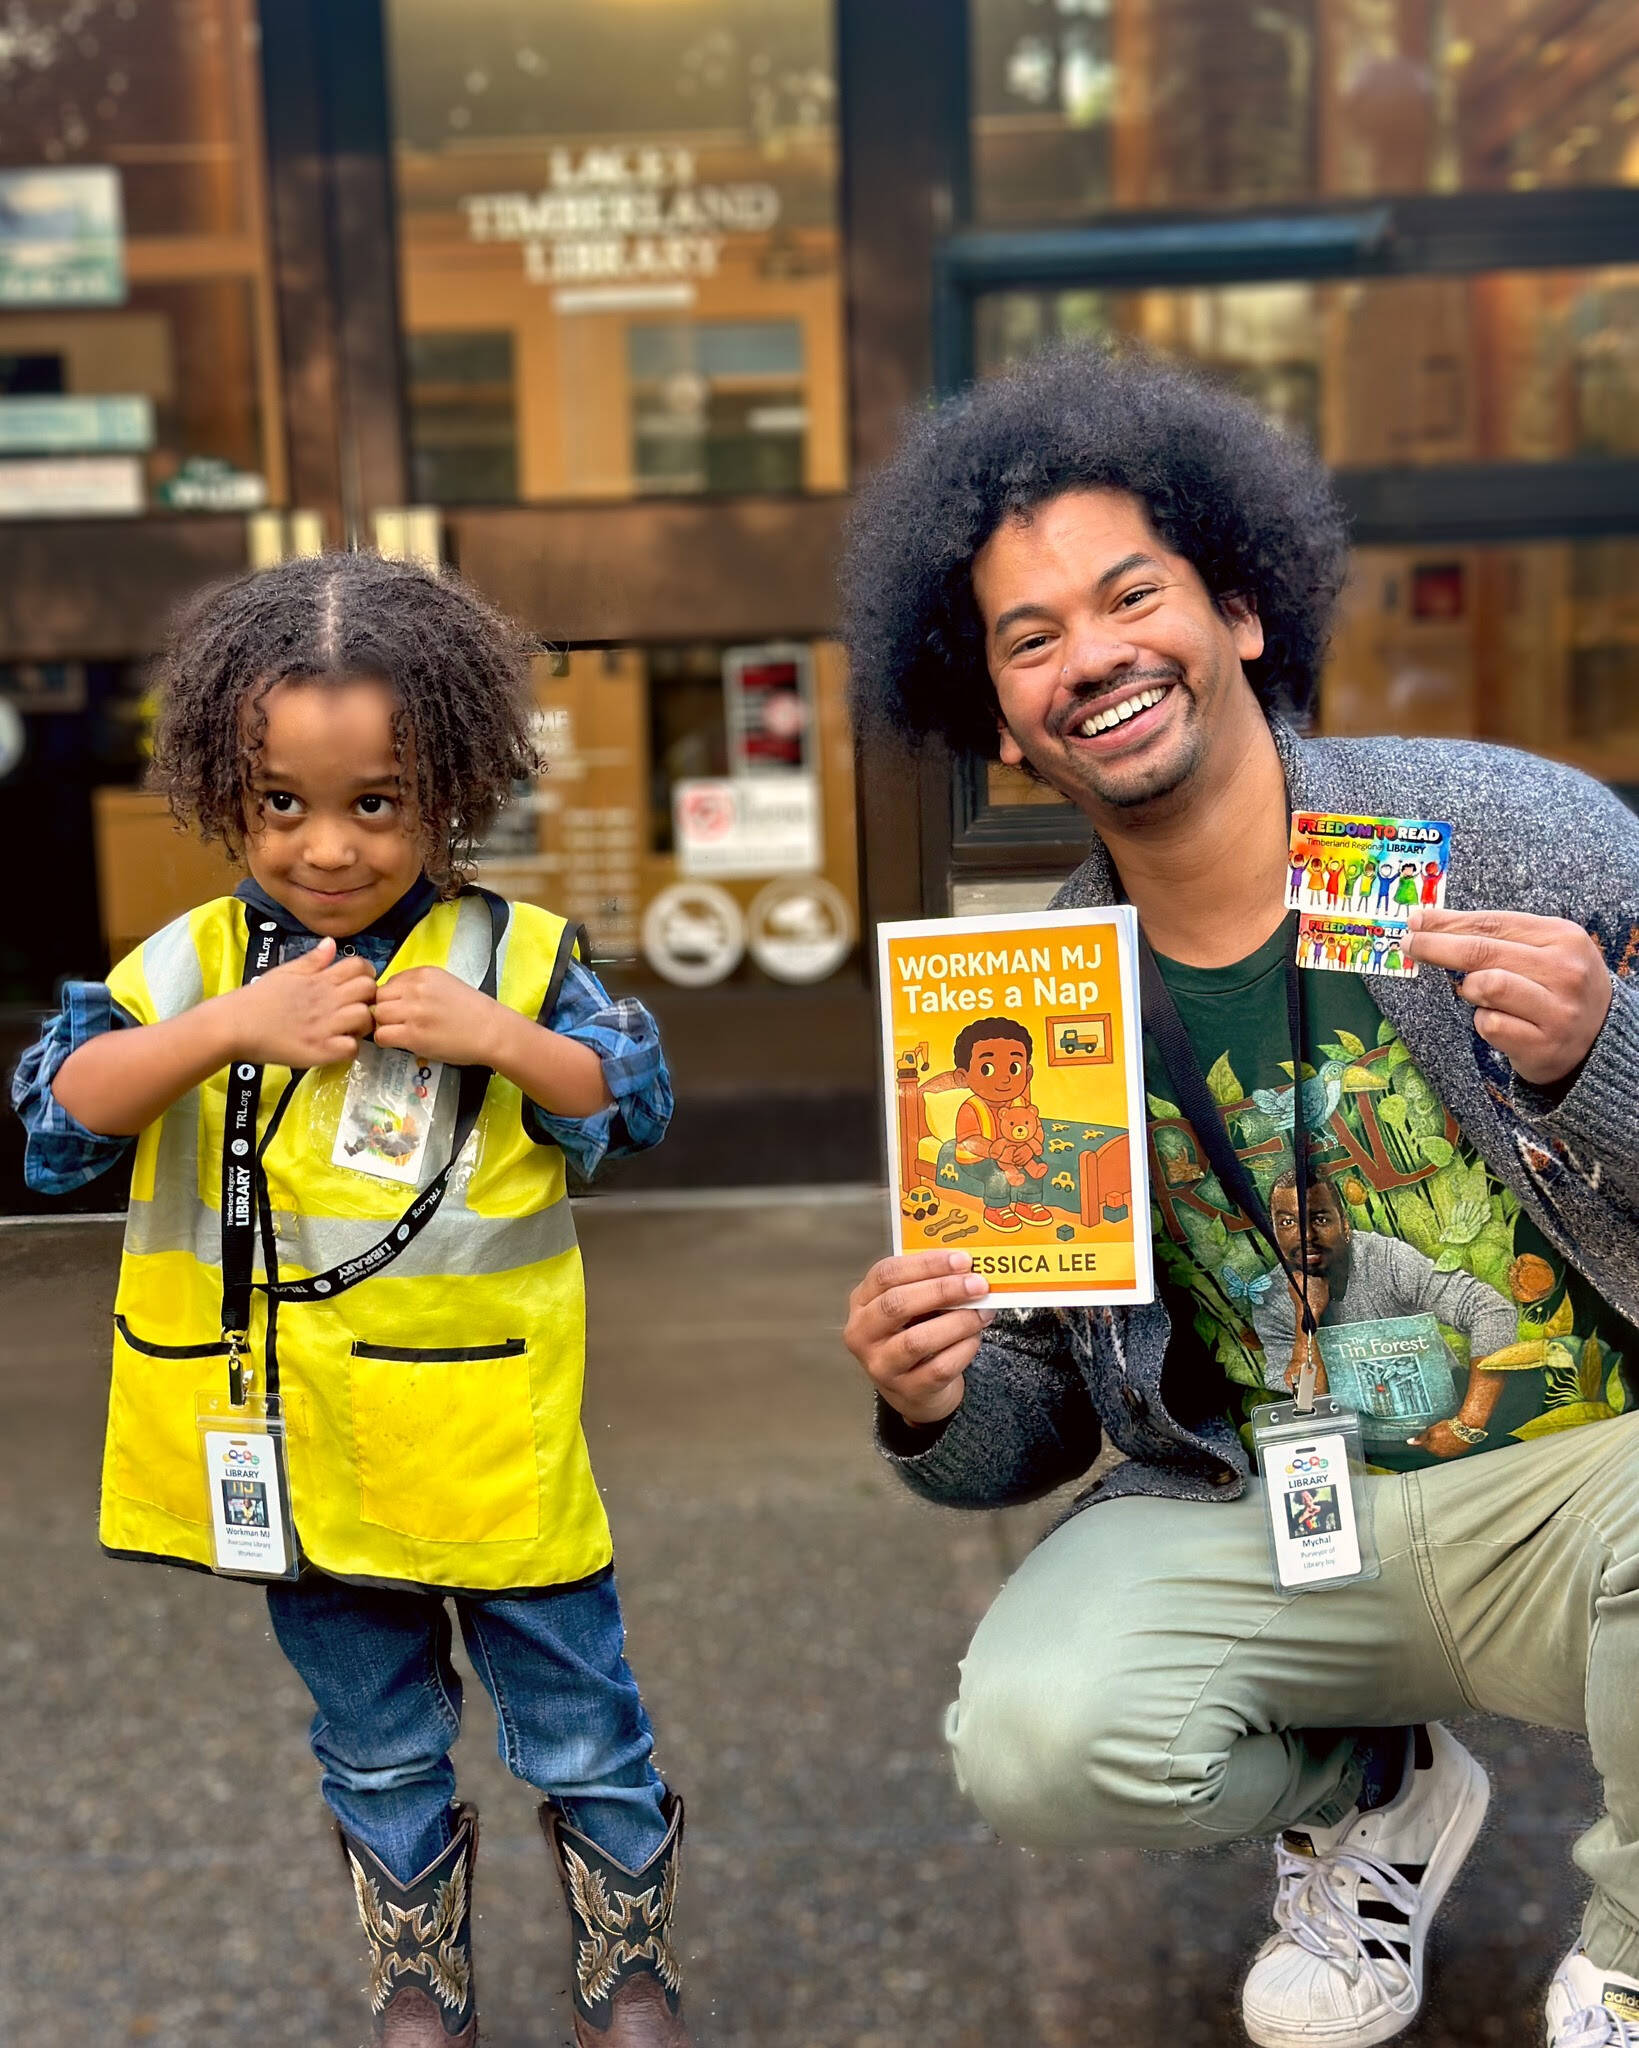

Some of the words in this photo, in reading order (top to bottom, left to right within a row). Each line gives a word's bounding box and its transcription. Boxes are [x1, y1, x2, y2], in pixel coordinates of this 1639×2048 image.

[1298, 818, 1374, 838] FREEDOM
[1397, 826, 1442, 843] READ
[1306, 837, 1350, 848] Timberland
[1351, 842, 1384, 852] Regional
[1386, 843, 1427, 855] LIBRARY
[1308, 919, 1367, 936] FREEDOM
[1384, 927, 1409, 940] REA
[897, 947, 1050, 981] WORKMAN
[1061, 943, 1102, 971] MJ
[902, 982, 994, 1014] Takes
[1004, 985, 1023, 1008] a
[1033, 976, 1099, 1011] Nap
[236, 1165, 250, 1227] LIBRARY
[338, 1241, 392, 1280] LIBRARY
[970, 1254, 1050, 1274] ESSICA
[1058, 1253, 1097, 1272] LEE
[1331, 1343, 1366, 1359] Tin
[1370, 1335, 1430, 1355] Forest
[225, 1468, 260, 1479] LIBRARY
[1288, 1474, 1329, 1489] LIBRARY
[226, 1527, 259, 1537] Workman
[1302, 1535, 1331, 1548] Mychal
